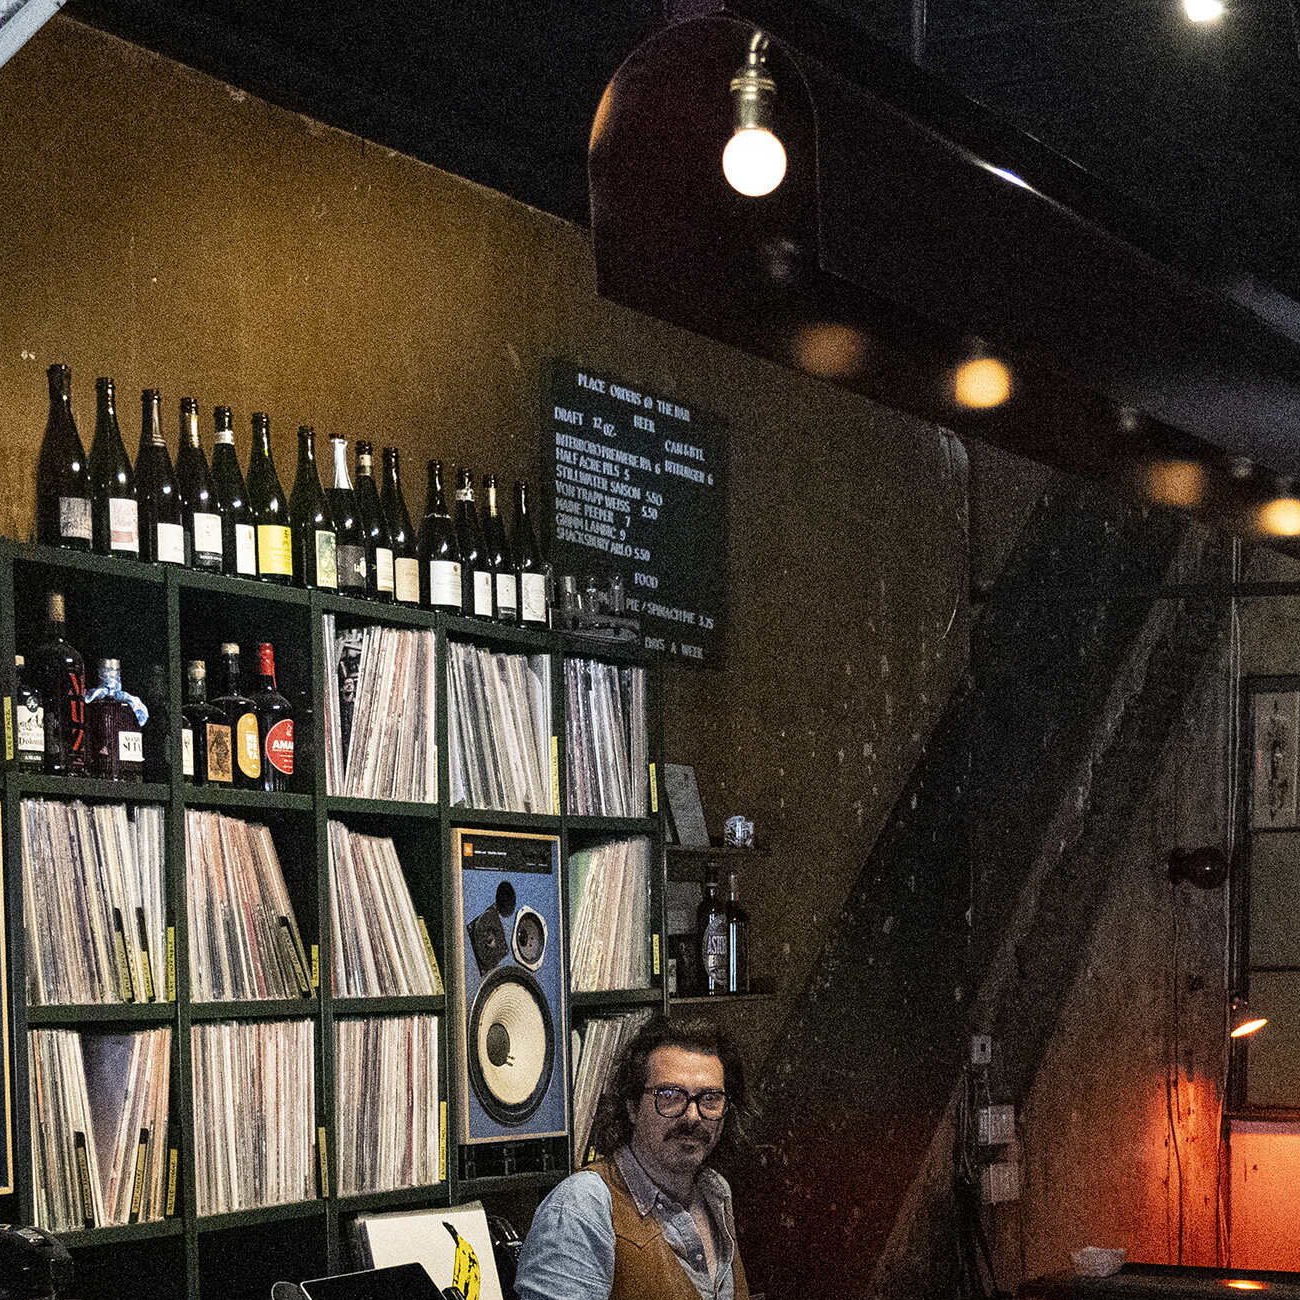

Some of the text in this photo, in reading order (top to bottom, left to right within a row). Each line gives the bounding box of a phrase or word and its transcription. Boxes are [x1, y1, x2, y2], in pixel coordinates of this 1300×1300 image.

[578, 373, 605, 394] PLACE
[610, 384, 641, 406] ORDERS
[656, 399, 674, 415] THE
[674, 406, 690, 422] BAR
[554, 406, 584, 426] DRAFT
[634, 414, 655, 433] BEER
[664, 440, 683, 455] CAN
[555, 447, 579, 465] HALF
[579, 455, 601, 473] ACRE
[624, 468, 630, 481] 5
[655, 463, 661, 475] 6
[555, 479, 576, 499] VON
[584, 504, 614, 524] PEEPER
[619, 529, 626, 541] 9
[634, 572, 659, 589] FOOD
